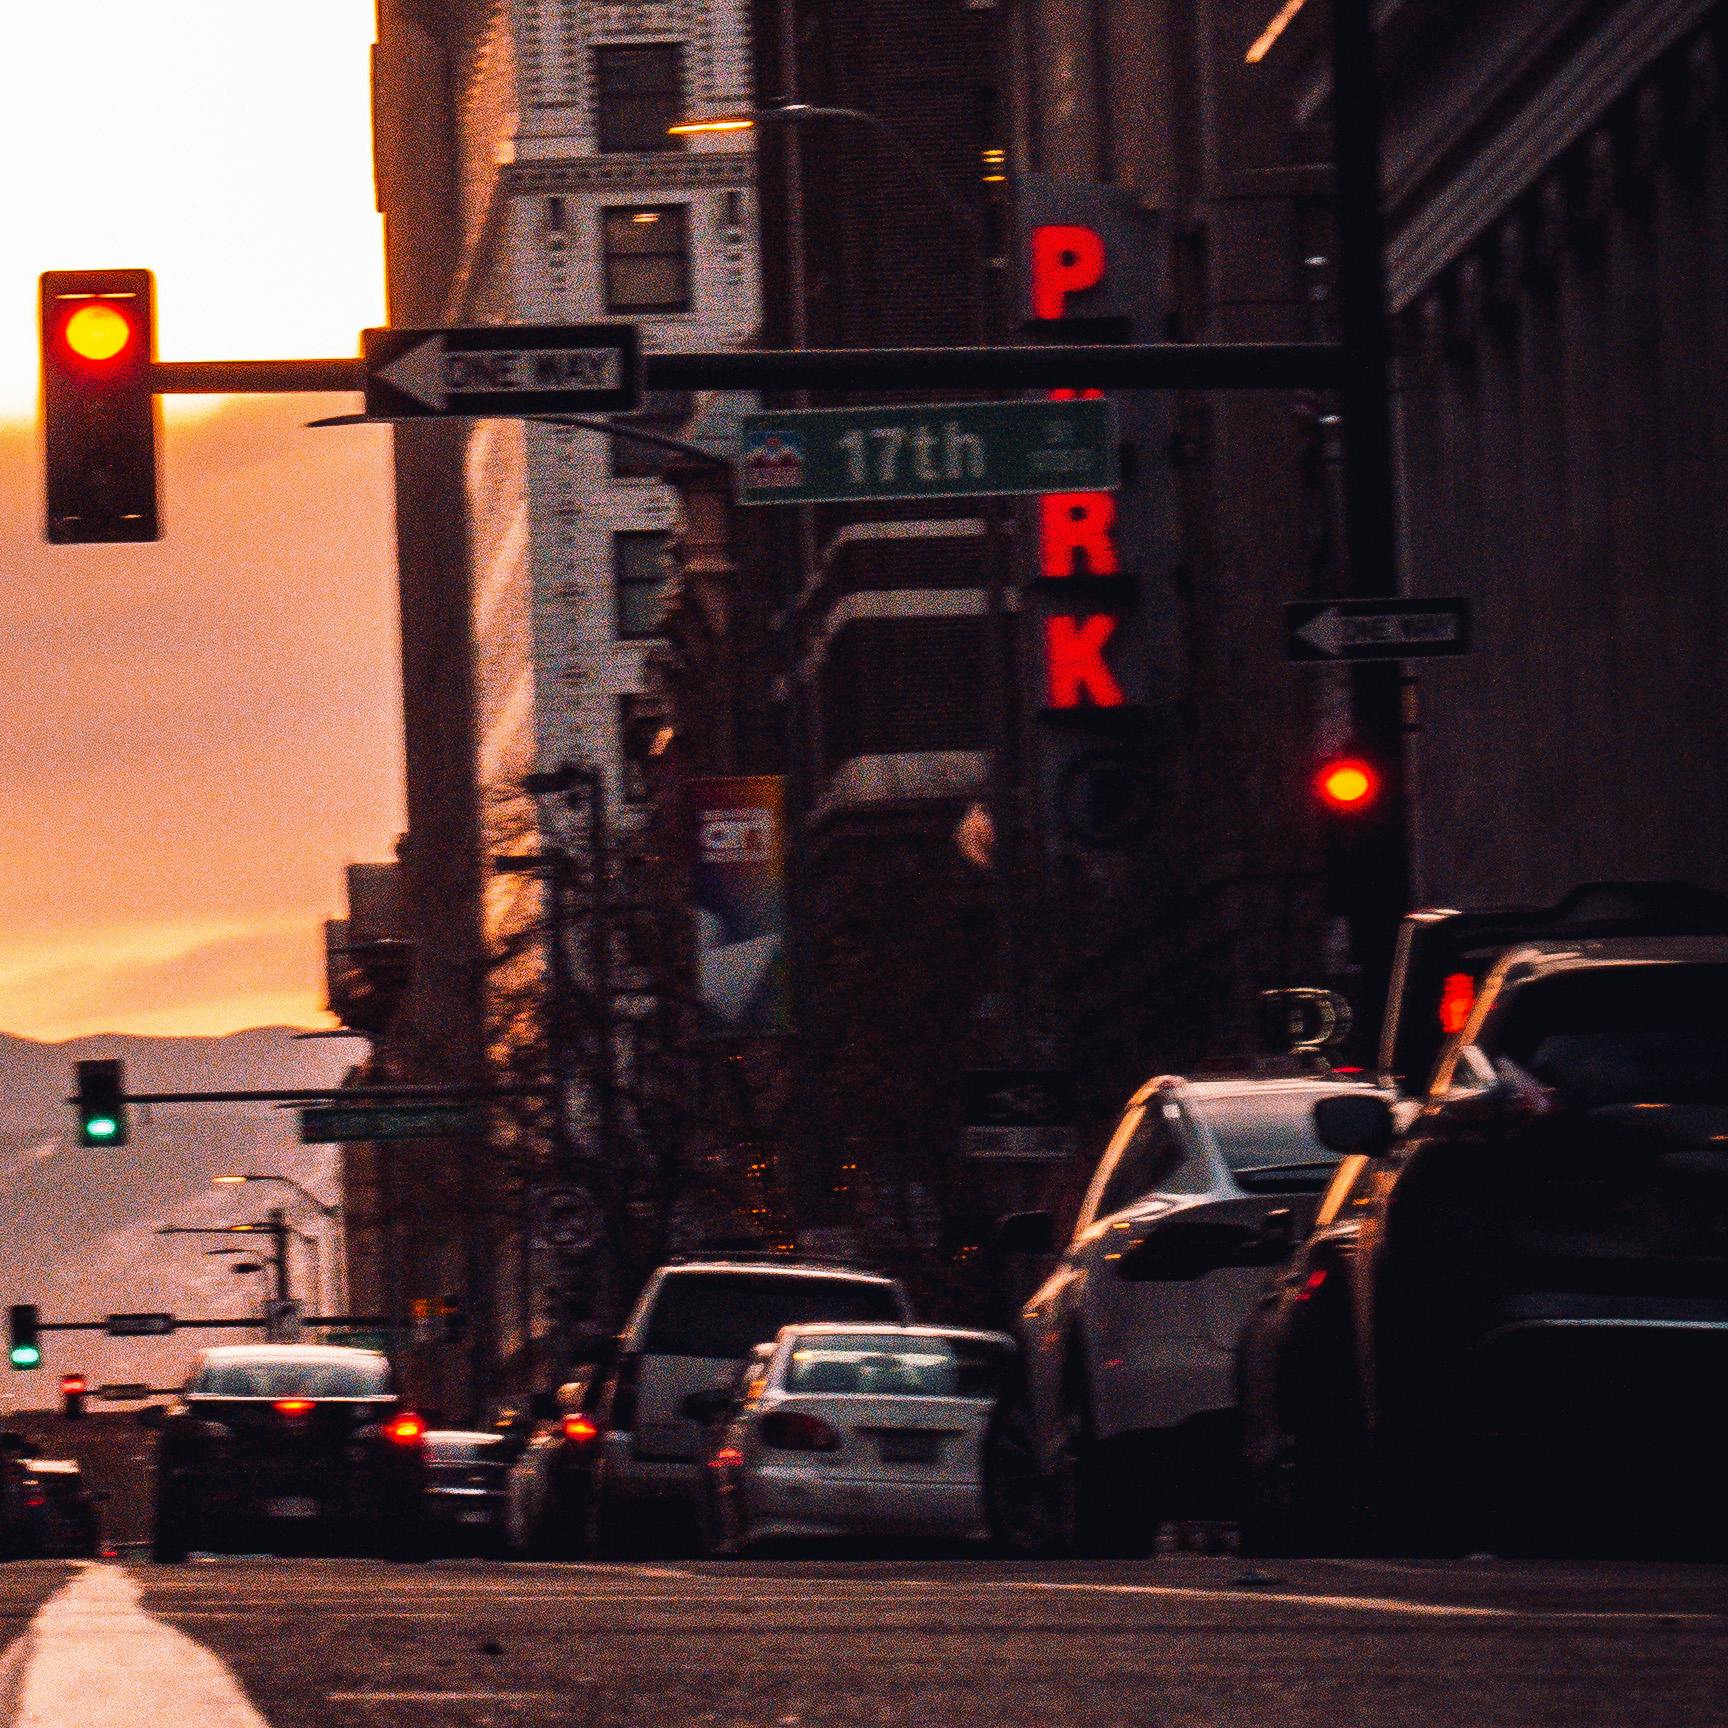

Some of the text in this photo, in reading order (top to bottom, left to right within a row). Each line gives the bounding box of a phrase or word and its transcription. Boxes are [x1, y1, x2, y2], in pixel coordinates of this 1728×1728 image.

[444, 350, 612, 388] ONE WAY
[834, 420, 987, 485] 17th
[1030, 224, 1126, 708] PRK
